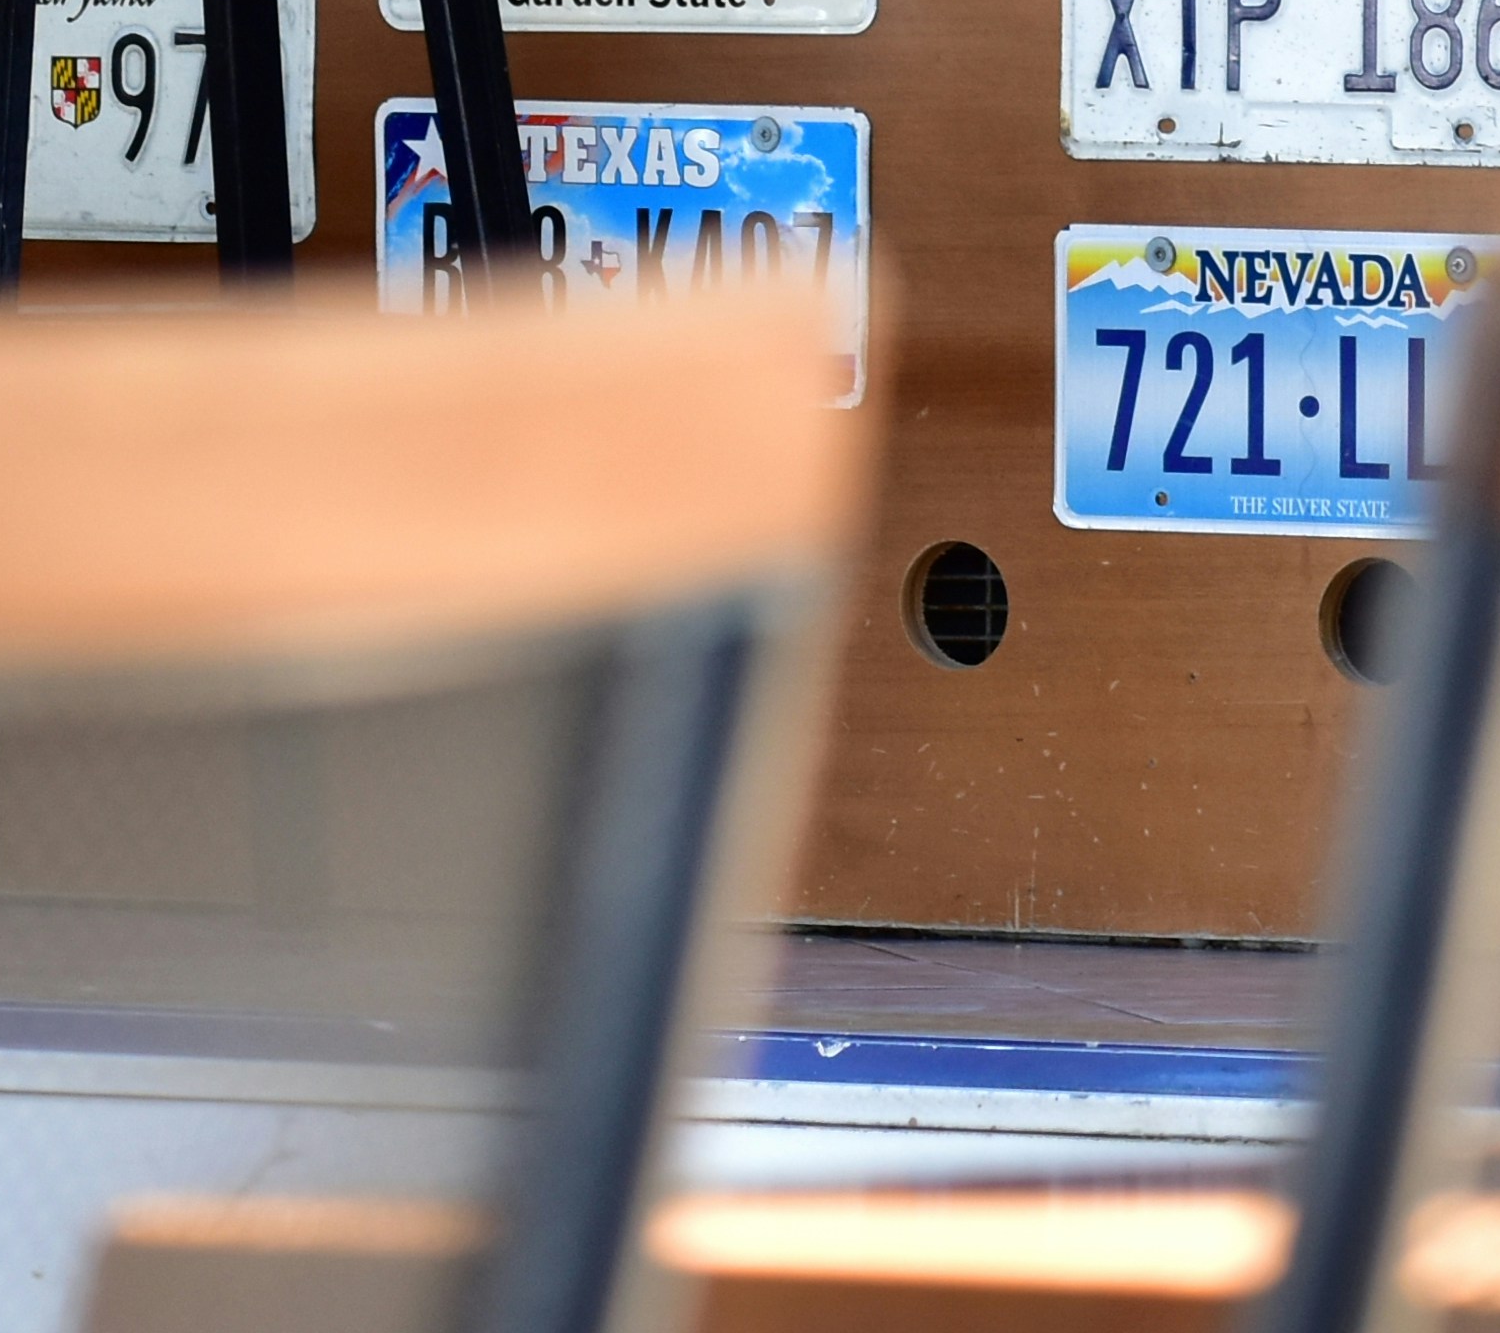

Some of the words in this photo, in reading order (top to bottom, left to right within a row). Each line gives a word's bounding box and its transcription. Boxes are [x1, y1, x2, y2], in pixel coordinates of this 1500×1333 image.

[518, 123, 722, 188] TEXAS
[1193, 249, 1432, 309] NEVADA
[1230, 494, 1268, 516] THE
[1271, 495, 1333, 518] SILVER
[1335, 498, 1391, 520] STATE
